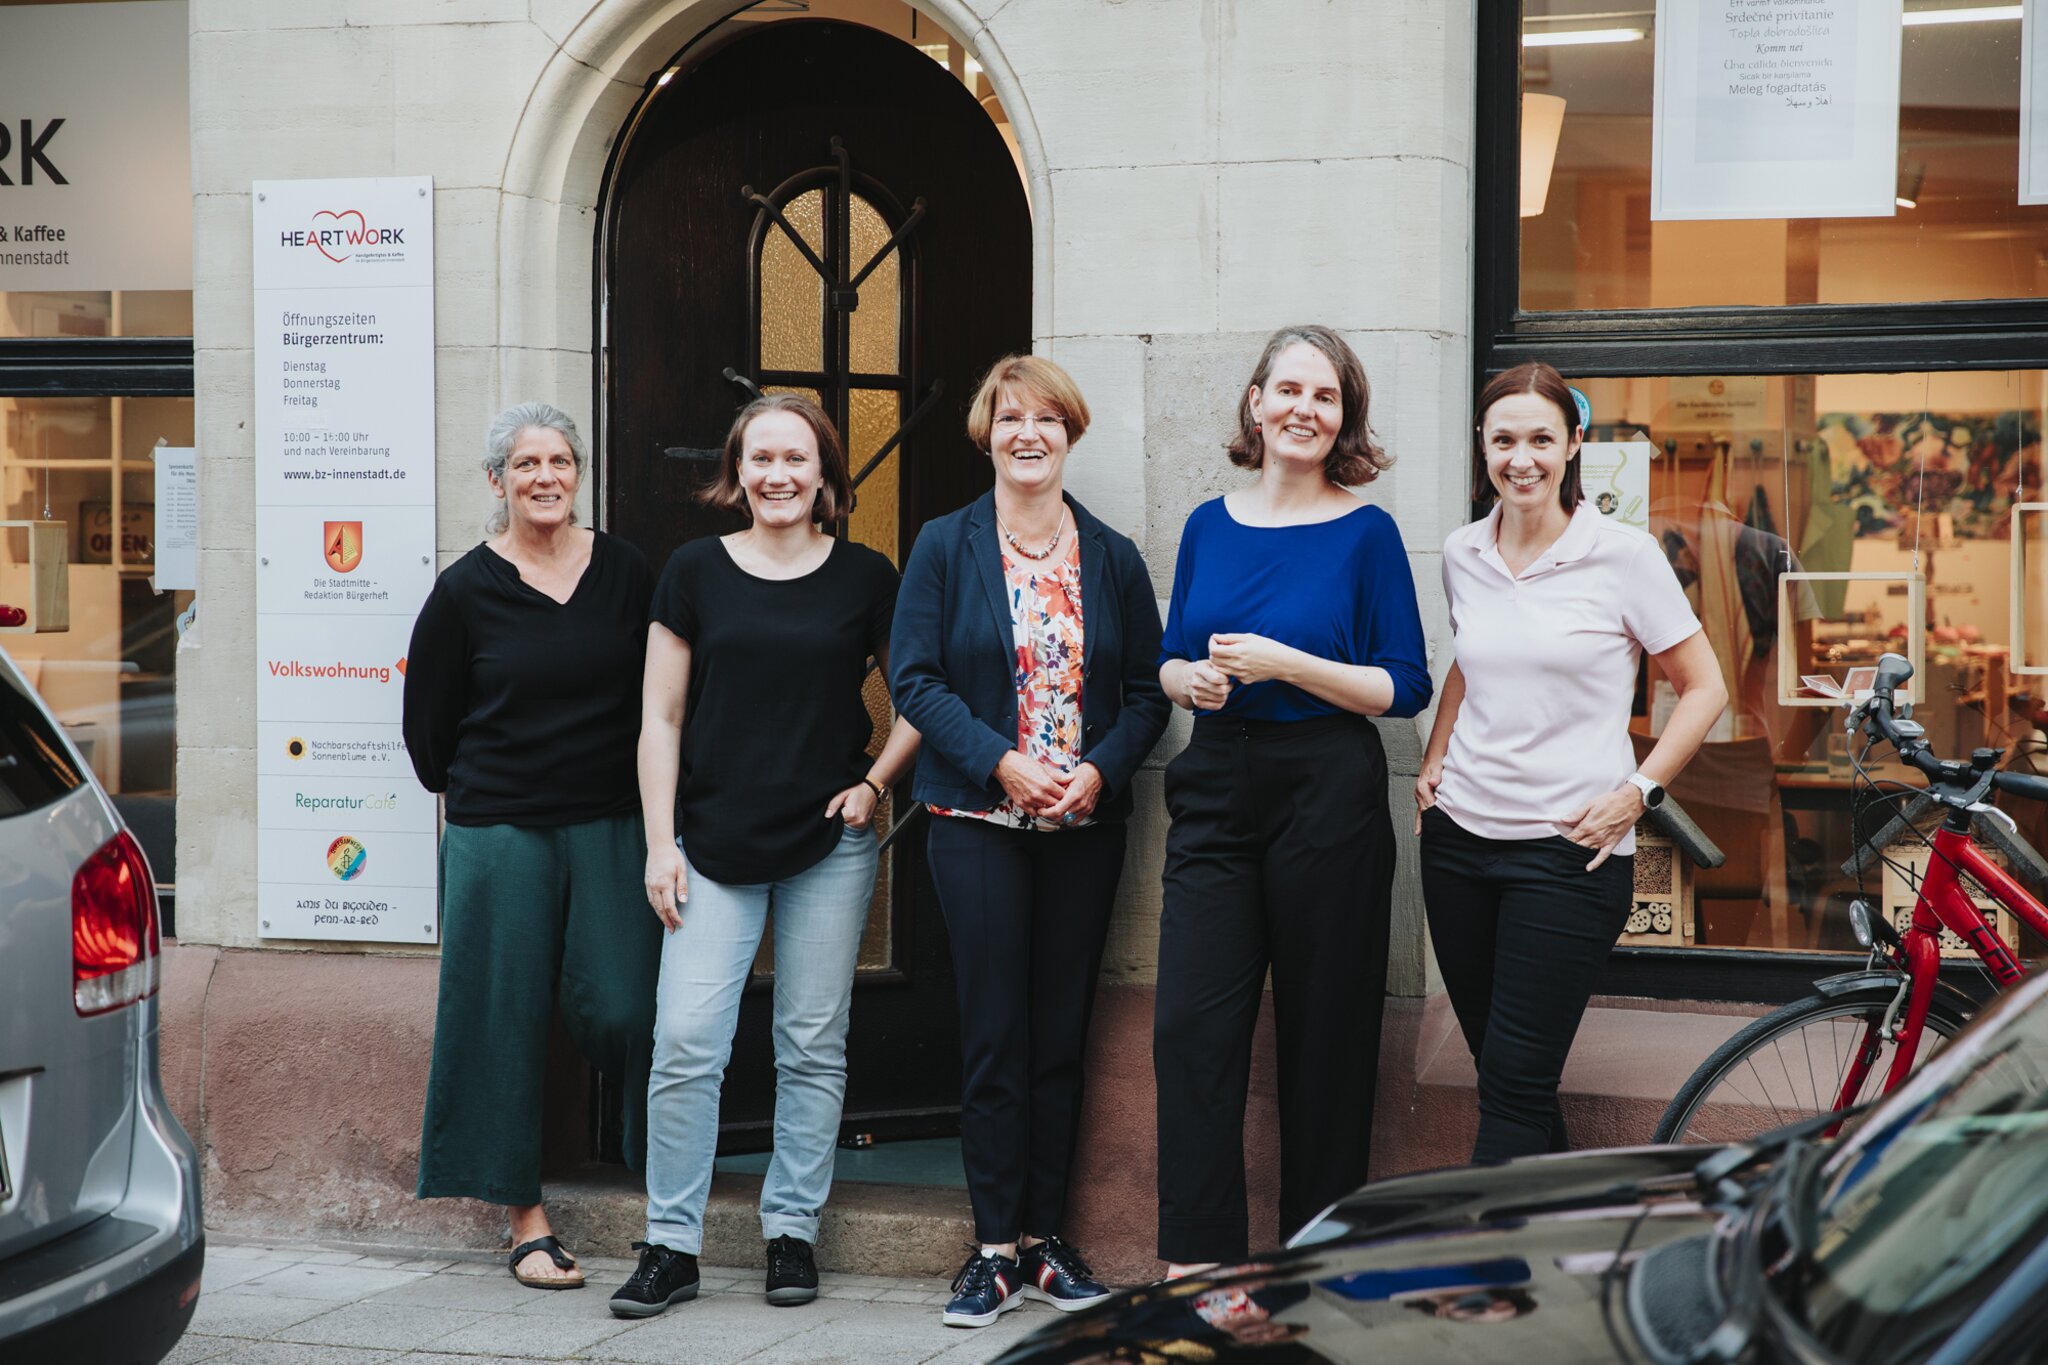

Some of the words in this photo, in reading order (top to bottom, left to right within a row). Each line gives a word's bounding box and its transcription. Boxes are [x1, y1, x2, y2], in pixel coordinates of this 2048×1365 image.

[1725, 10, 1773, 23] Srdečné
[1728, 27, 1760, 40] Topla
[1756, 43, 1786, 54] Komm
[1728, 84, 1763, 96] Meleg
[1766, 82, 1827, 95] fogadtatás
[0, 118, 70, 186] K
[14, 225, 66, 242] Kaffee
[281, 228, 405, 247] HEARTWORK
[282, 312, 376, 328] Öffnungszeiten
[283, 333, 384, 348] Bürgerzentrum:
[283, 361, 327, 373] Dienstag
[283, 378, 341, 390] Donnerstag
[283, 395, 318, 408] Freitag
[284, 432, 311, 442] 10:00
[352, 432, 369, 442] Uhr
[284, 446, 301, 456] und
[304, 446, 327, 456] nach
[329, 446, 390, 458] Vereinbarung
[284, 469, 406, 480] www.bz-innenstadt.de
[313, 579, 327, 588] Die
[329, 578, 371, 588] Stadtmitte
[304, 590, 344, 600] Redaktion
[346, 590, 389, 601] Bürgerheft
[268, 660, 390, 683] Volkswohnung
[312, 751, 367, 761] Sonnenblume
[371, 753, 391, 761] e.V.
